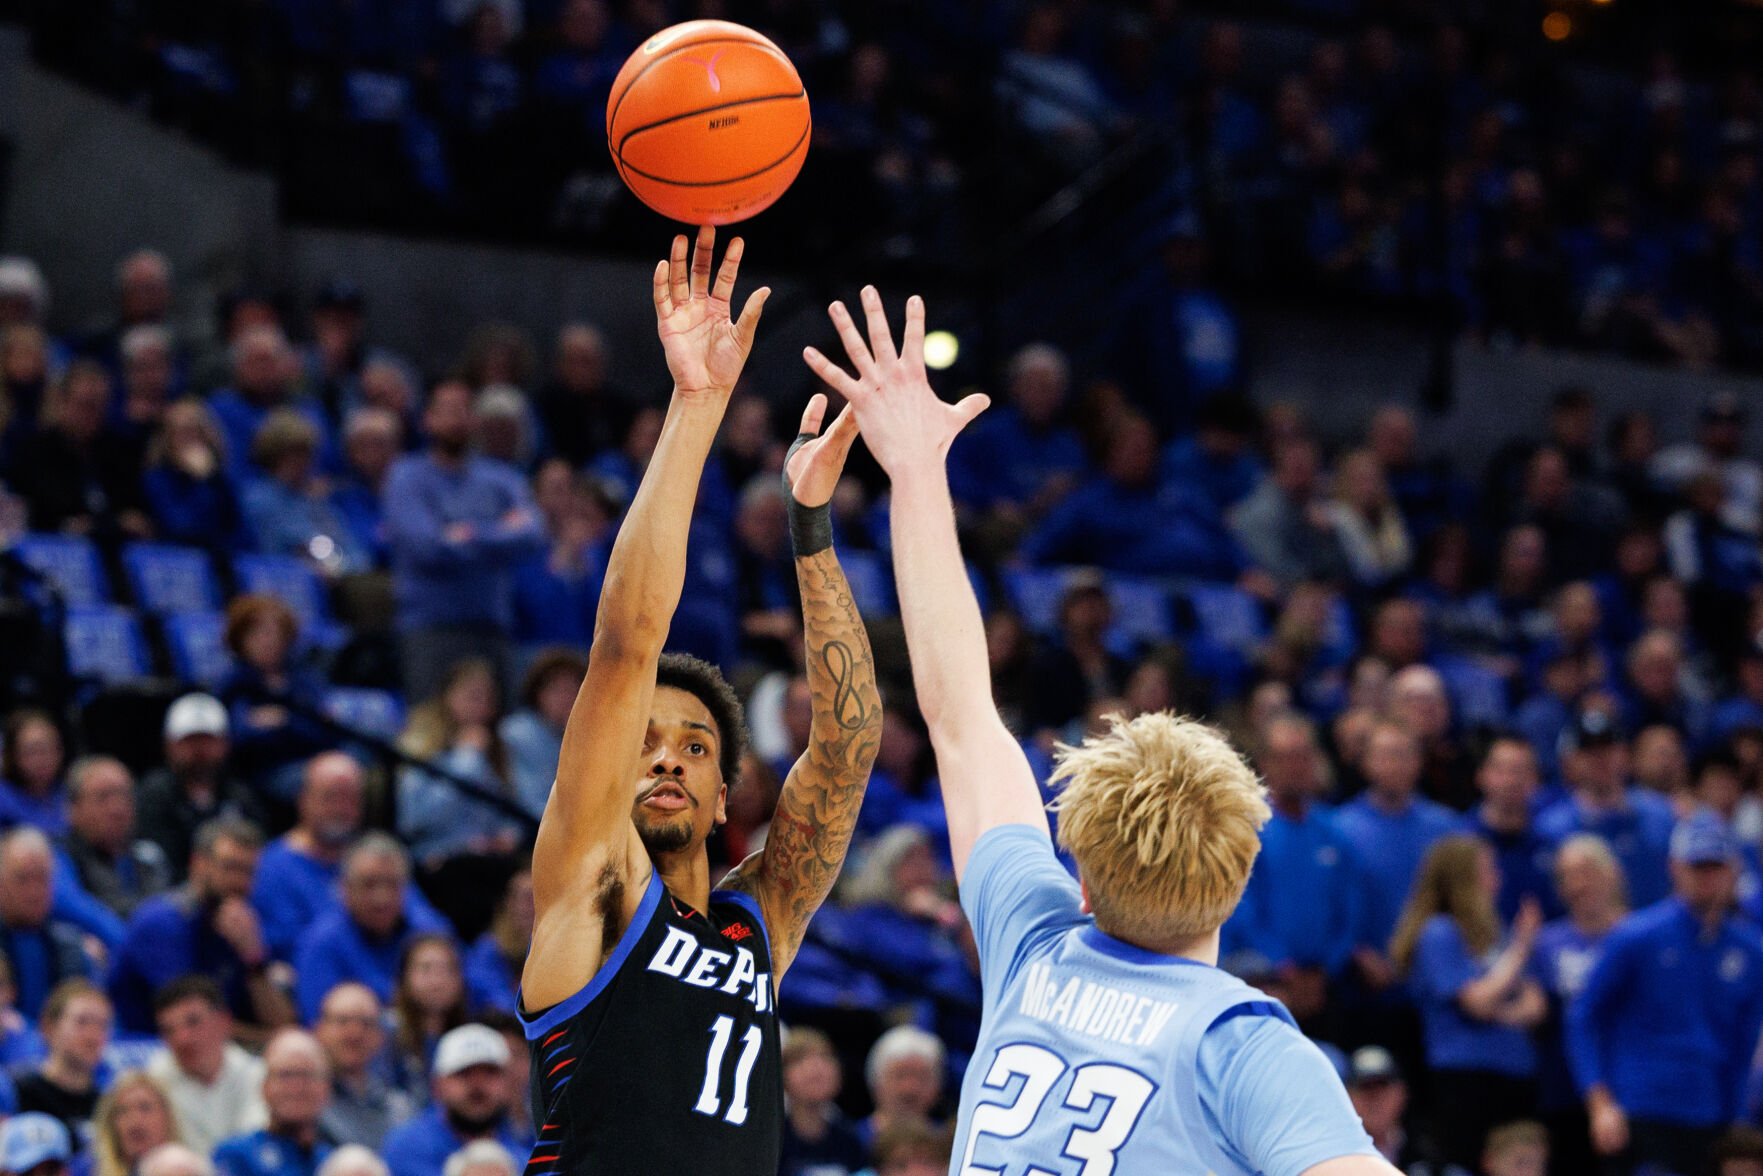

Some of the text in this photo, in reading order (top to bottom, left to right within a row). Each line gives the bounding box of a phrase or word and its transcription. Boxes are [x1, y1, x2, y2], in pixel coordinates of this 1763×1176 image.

[1018, 963, 1179, 1047] McANDREW
[692, 1013, 763, 1126] 11
[958, 1041, 1160, 1176] 23
